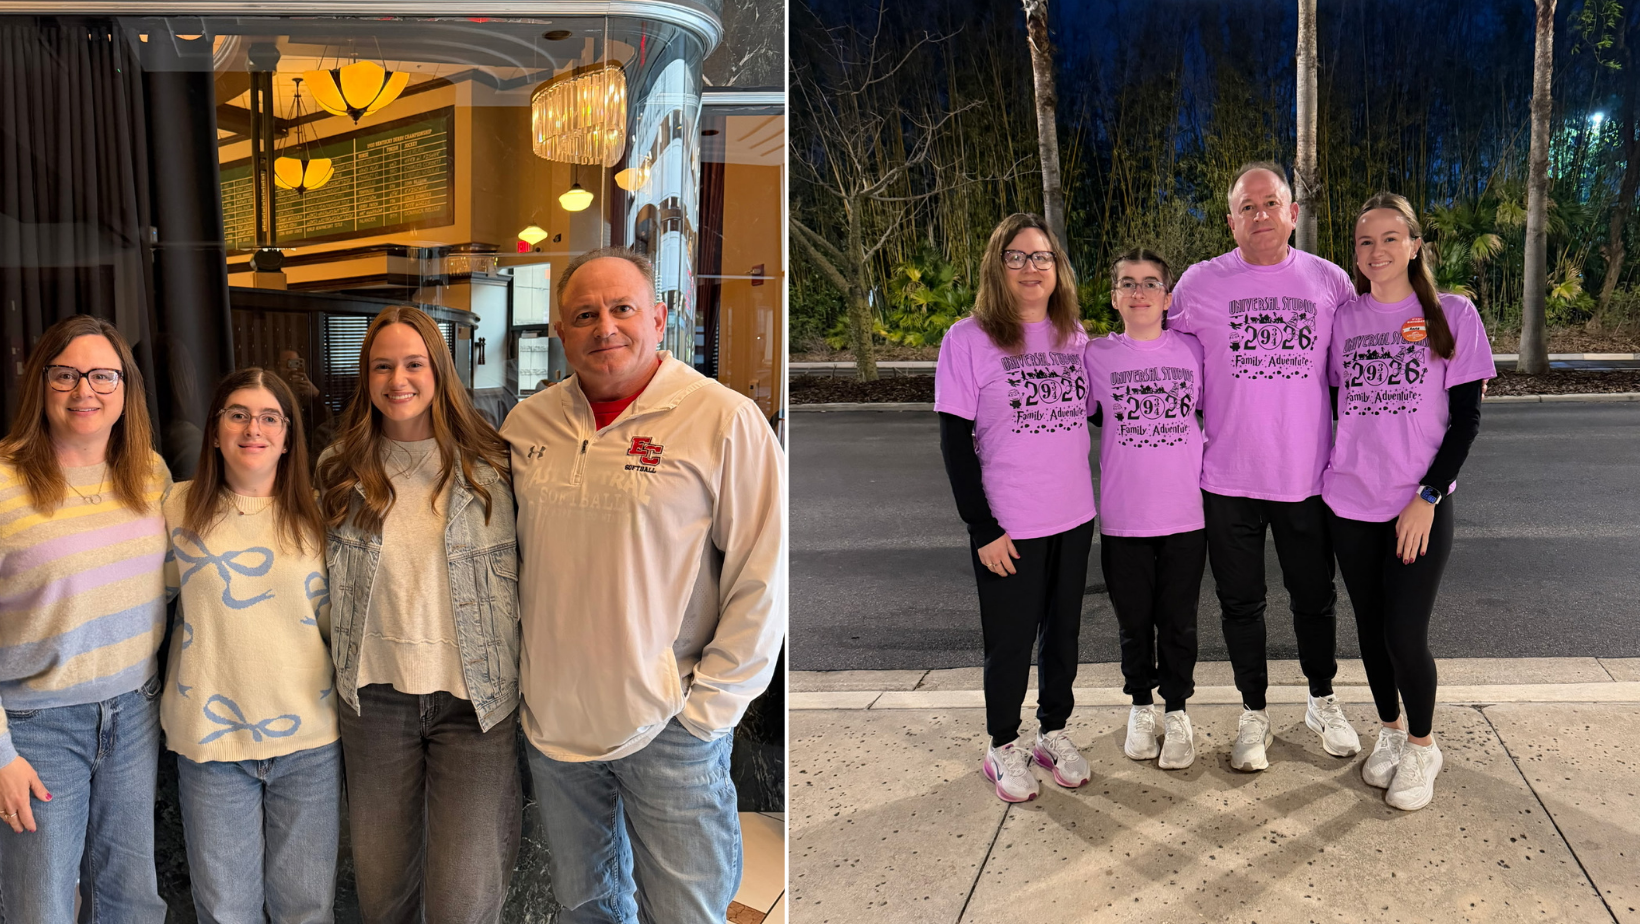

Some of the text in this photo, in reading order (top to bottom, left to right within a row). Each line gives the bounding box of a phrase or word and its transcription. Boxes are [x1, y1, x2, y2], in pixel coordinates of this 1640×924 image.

[1229, 296, 1317, 316] UNIVERSAL STUDIOS
[1001, 352, 1050, 371] UNIVERSAL
[1235, 355, 1309, 368] Family Adventure
[1110, 367, 1161, 385] UNIVERSAL
[1374, 390, 1417, 404] Adventure
[1016, 410, 1044, 425] Family
[1120, 424, 1147, 437] Family
[627, 436, 664, 467] EC
[624, 464, 656, 474] SOFTBALL
